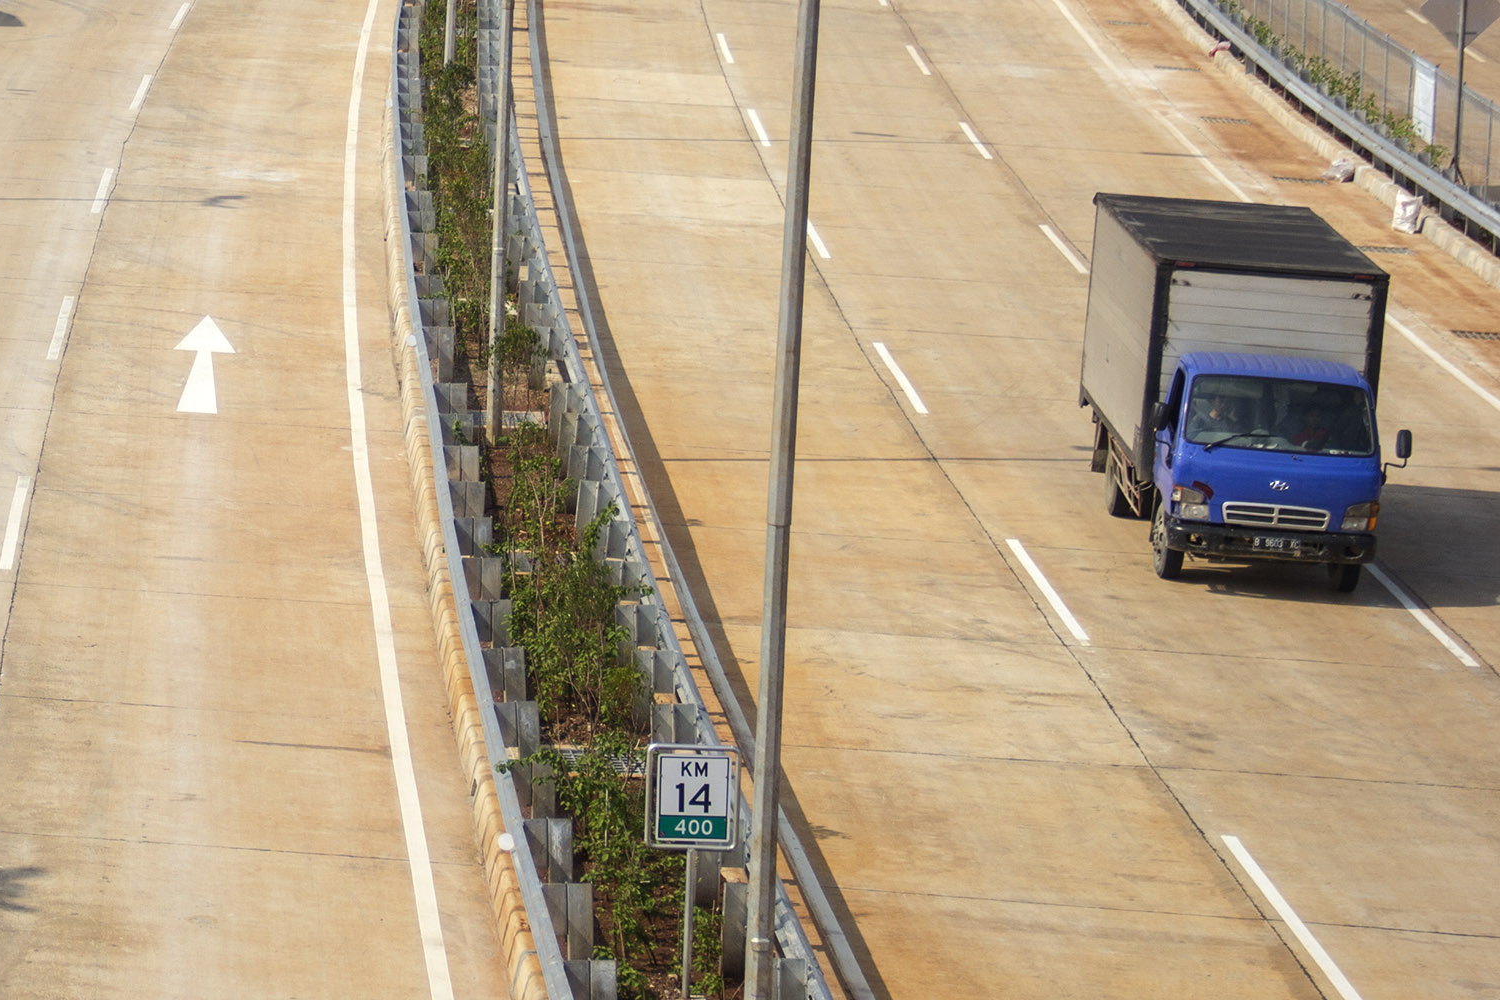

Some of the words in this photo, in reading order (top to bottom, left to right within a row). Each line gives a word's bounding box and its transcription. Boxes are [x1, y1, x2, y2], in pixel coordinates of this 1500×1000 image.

[681, 761, 708, 777] KM
[675, 782, 712, 813] 14
[674, 818, 713, 836] 400
